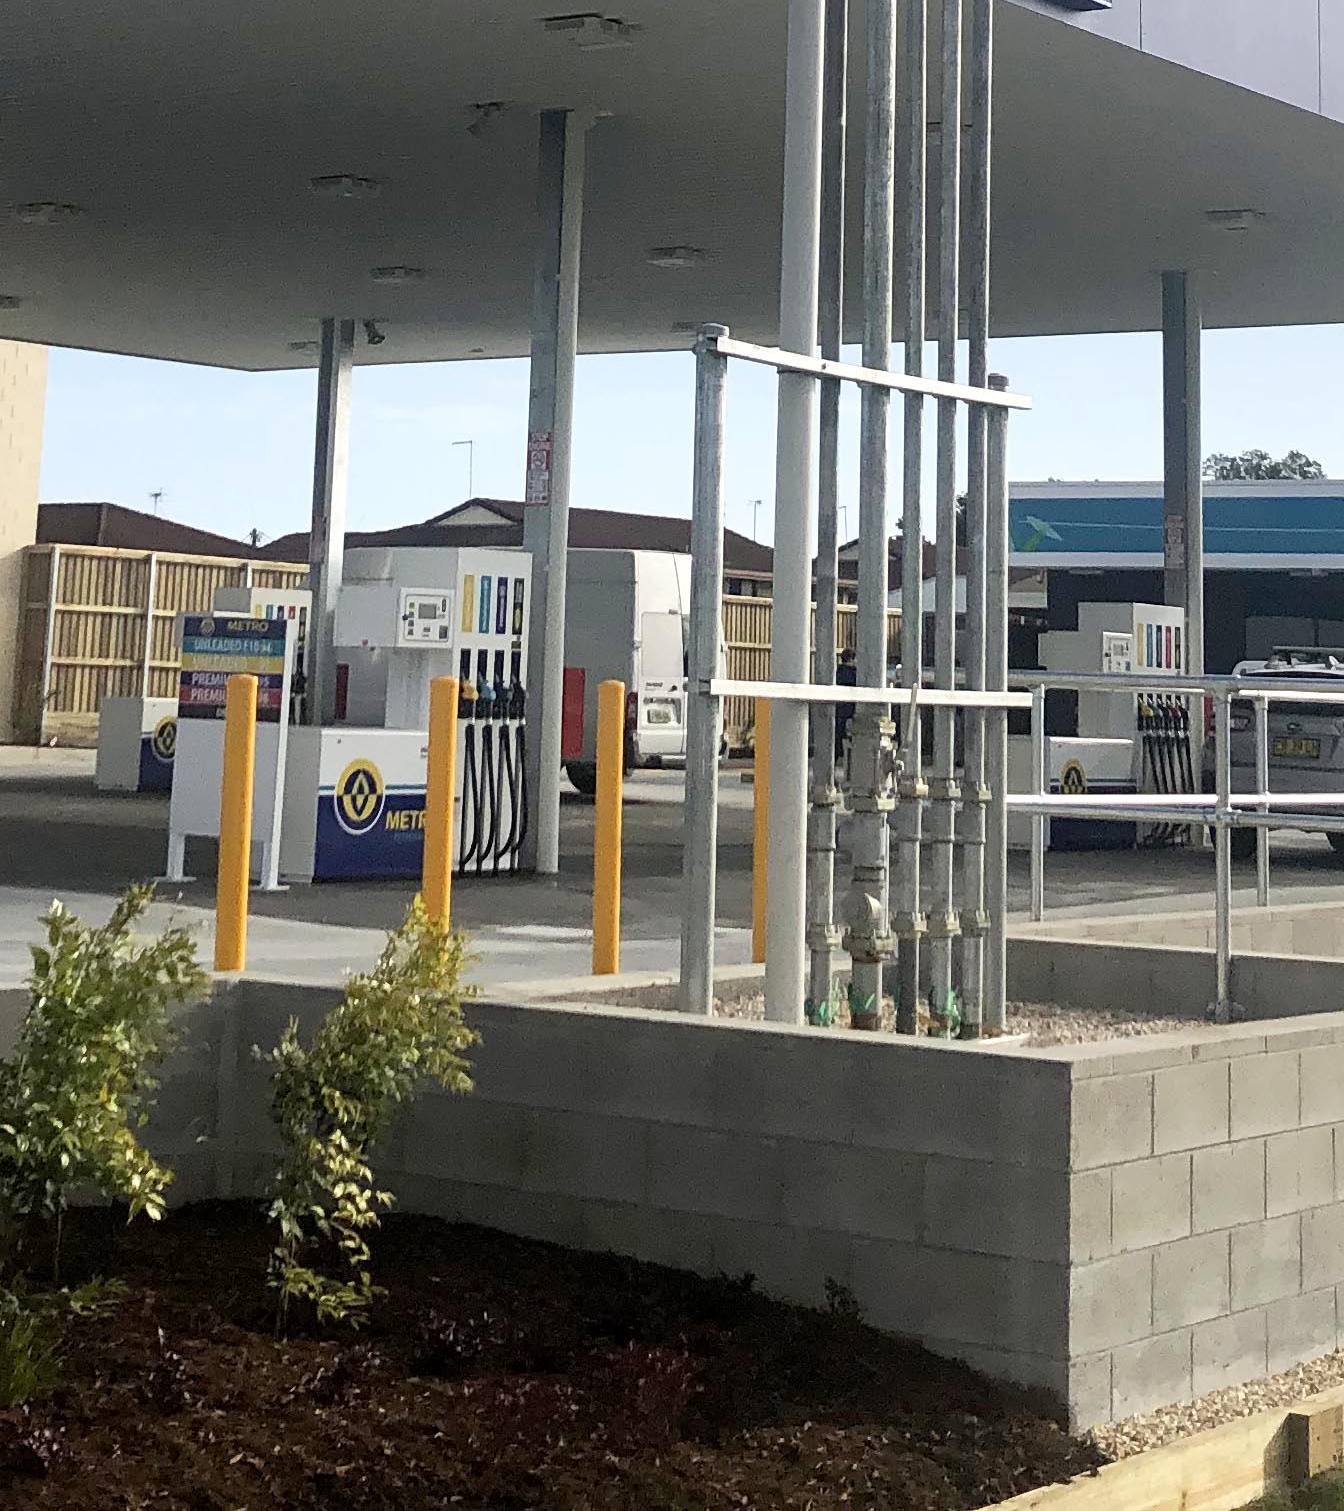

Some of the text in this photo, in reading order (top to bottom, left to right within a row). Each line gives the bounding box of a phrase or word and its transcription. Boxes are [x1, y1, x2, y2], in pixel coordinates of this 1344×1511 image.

[227, 620, 270, 632] METRO
[194, 638, 242, 651] UNLEADED
[191, 672, 227, 685] PREMI
[190, 688, 226, 702] PREMI
[385, 810, 428, 830] METR
